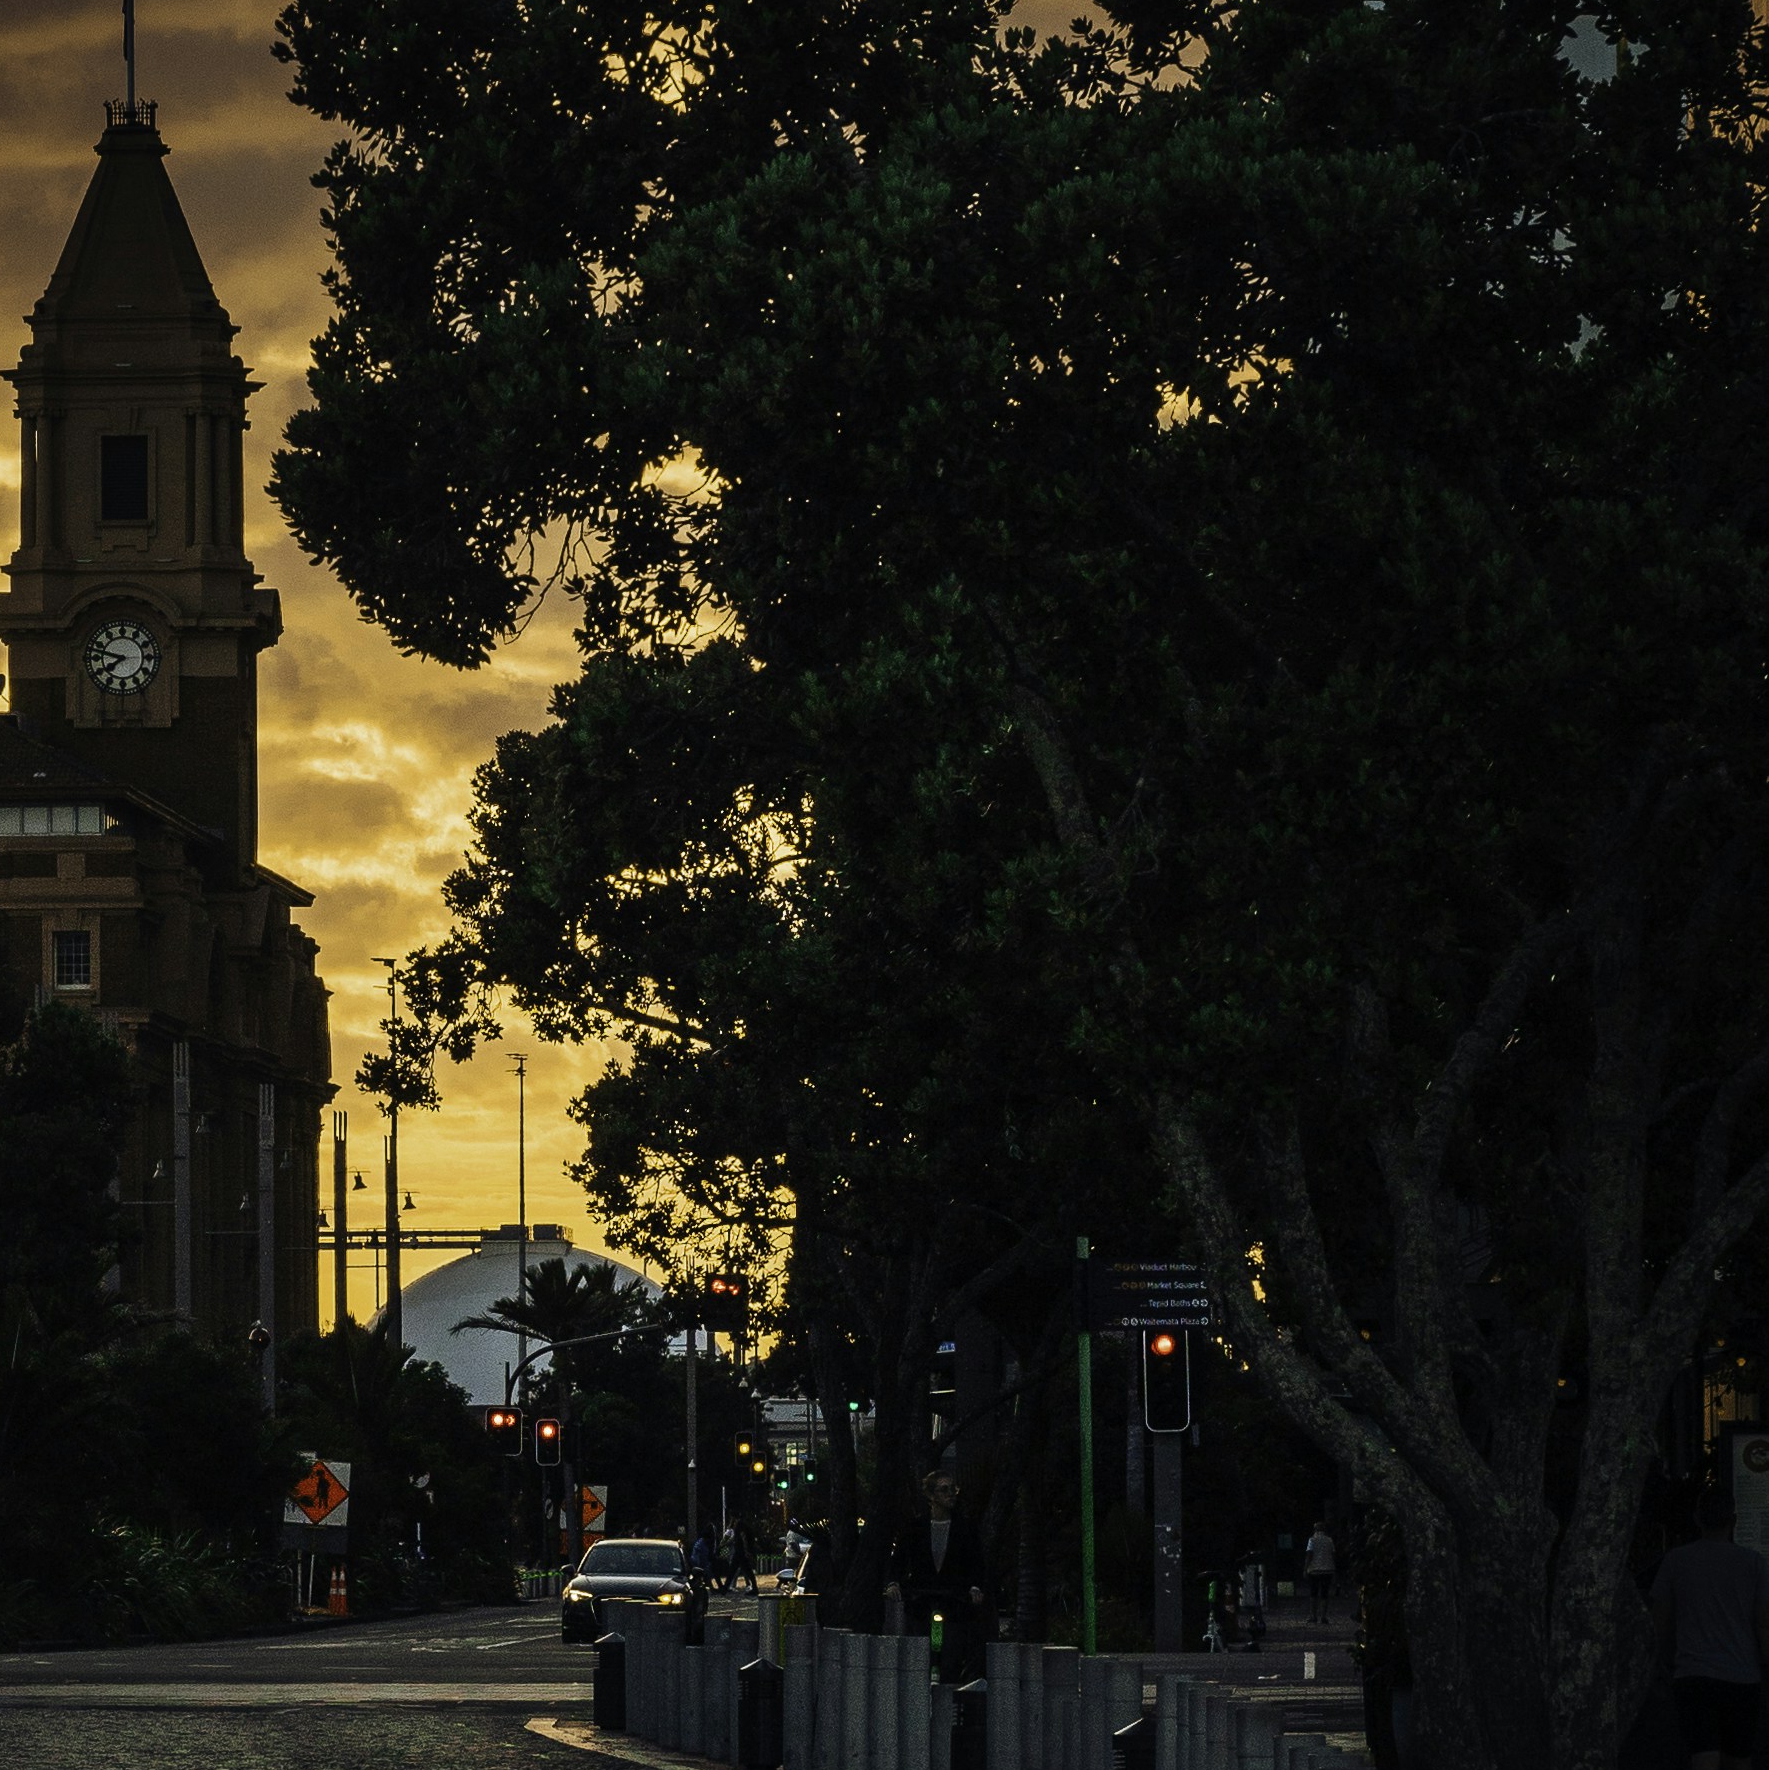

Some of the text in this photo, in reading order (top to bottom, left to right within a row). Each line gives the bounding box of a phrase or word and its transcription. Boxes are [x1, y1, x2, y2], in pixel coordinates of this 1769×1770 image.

[1139, 1263, 1198, 1271] Viaduct Harbou
[1147, 1281, 1200, 1291] Market Square
[1148, 1299, 1169, 1309] Tepid
[1170, 1299, 1191, 1307] Baths
[1180, 1317, 1200, 1326] Plaza
